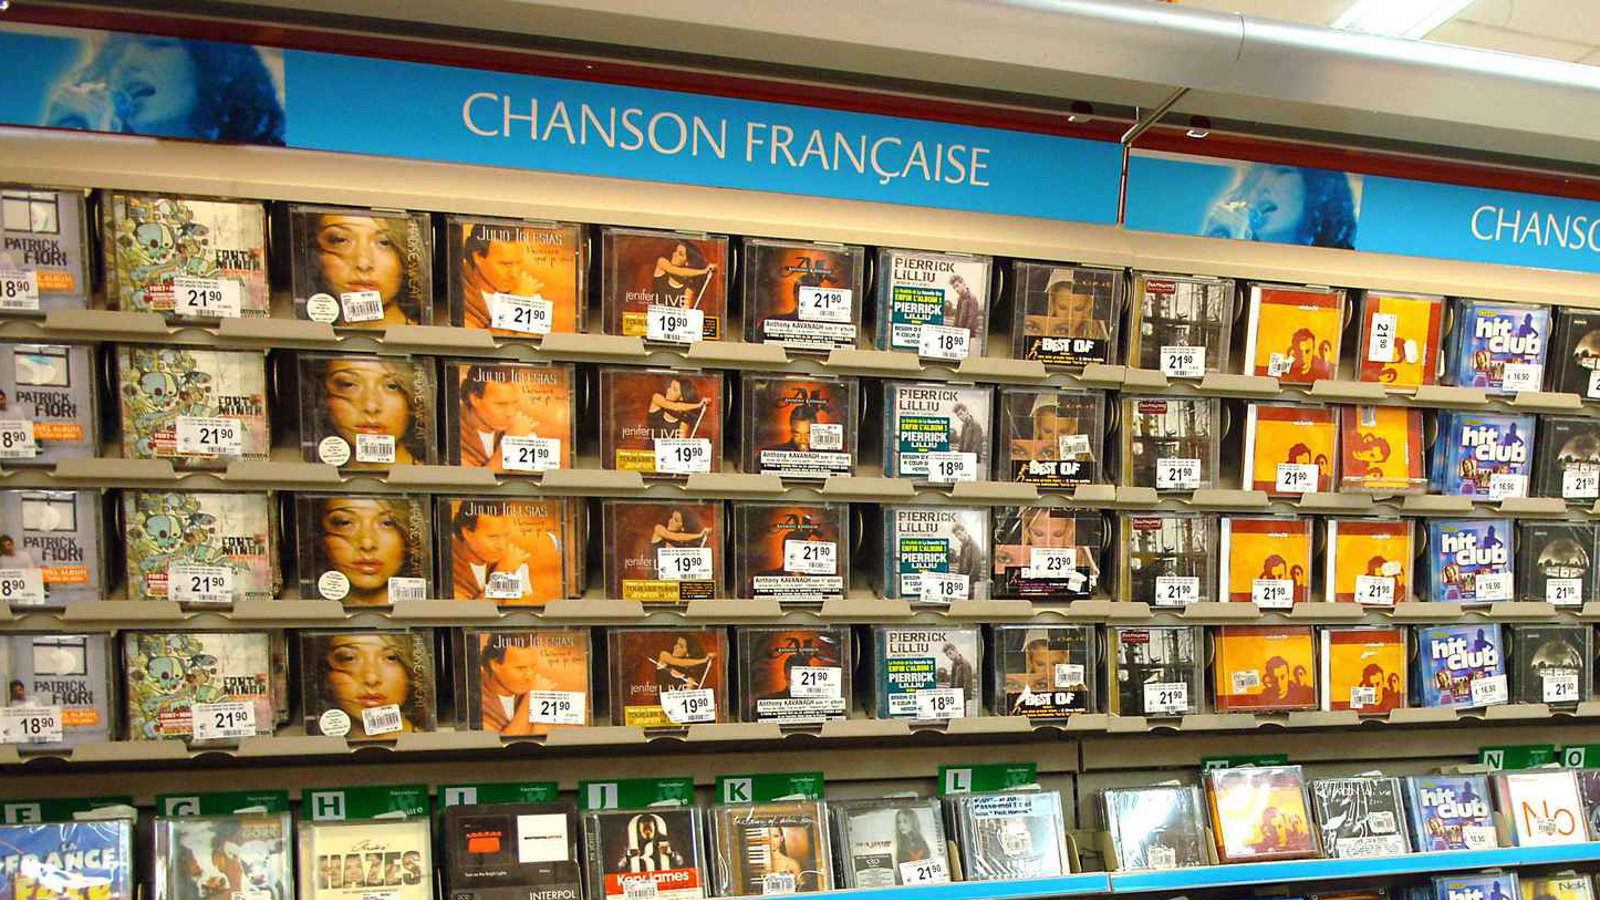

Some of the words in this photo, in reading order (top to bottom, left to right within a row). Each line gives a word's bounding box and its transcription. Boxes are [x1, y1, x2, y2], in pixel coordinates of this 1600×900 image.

[463, 92, 727, 160] CHANSON
[745, 122, 990, 186] FRANÇAISE
[476, 225, 509, 242] JULIO
[515, 227, 564, 246] IGLESIAS
[4, 237, 60, 251] PATRICK
[24, 250, 67, 266] FIORI
[895, 258, 955, 273] PIERRICK
[894, 269, 936, 283] LILLIU
[625, 288, 654, 303] jenifer
[656, 293, 689, 308] LIVE
[894, 301, 942, 315] PIERRICK
[766, 320, 791, 330] Anthony
[792, 322, 824, 331] KAVANAGH
[1476, 317, 1512, 338] hit
[1042, 338, 1068, 353] BEST
[1073, 339, 1095, 353] OF
[1488, 333, 1541, 355] club
[473, 367, 506, 383] JULIO
[511, 368, 558, 385] IGLESIAS
[16, 391, 70, 404] PATRICK
[900, 389, 958, 401] PIERRICK
[35, 402, 77, 418] FIORI
[900, 401, 939, 411] LILLIU
[3, 431, 26, 448] 890
[622, 425, 650, 439] jenifer
[901, 431, 948, 443] PIERRICK
[1462, 425, 1498, 447] hit
[789, 452, 820, 460] KAVANAGH
[1475, 442, 1525, 463] club
[1060, 462, 1081, 475] OF
[465, 502, 497, 516] JULIO
[502, 502, 548, 517] IGLESIAS
[899, 512, 956, 523] PIERRICK
[899, 523, 938, 533] LILLIU
[24, 536, 76, 549] PATRICK
[1442, 532, 1476, 553] hit
[42, 548, 84, 562] FIORI
[624, 555, 653, 569] jenifer
[901, 553, 947, 563] PIERRICK
[1456, 545, 1506, 566] club
[2, 580, 25, 597] 890
[493, 634, 525, 649] JULIO
[529, 634, 574, 647] IGLESIAS
[890, 632, 947, 643] PIERRICK
[890, 643, 929, 653] LILLIU
[1432, 637, 1467, 659] hit
[1448, 648, 1499, 670] club
[889, 672, 934, 683] PIERRICK
[34, 680, 87, 693] PATRICK
[630, 682, 658, 695] jenifer
[52, 691, 94, 705] FIORI
[759, 700, 783, 708] Anthony
[1025, 691, 1052, 706] BEST
[1055, 691, 1075, 705] OF
[1567, 752, 1582, 766] O
[954, 773, 965, 790] L
[598, 785, 607, 808] J
[729, 782, 747, 802] K
[1421, 788, 1456, 806] hit
[317, 796, 340, 816] H
[1438, 798, 1489, 819] club
[5, 848, 118, 873] FRANCE
[316, 851, 422, 890] HAZES
[529, 890, 576, 900] INTERPOL
